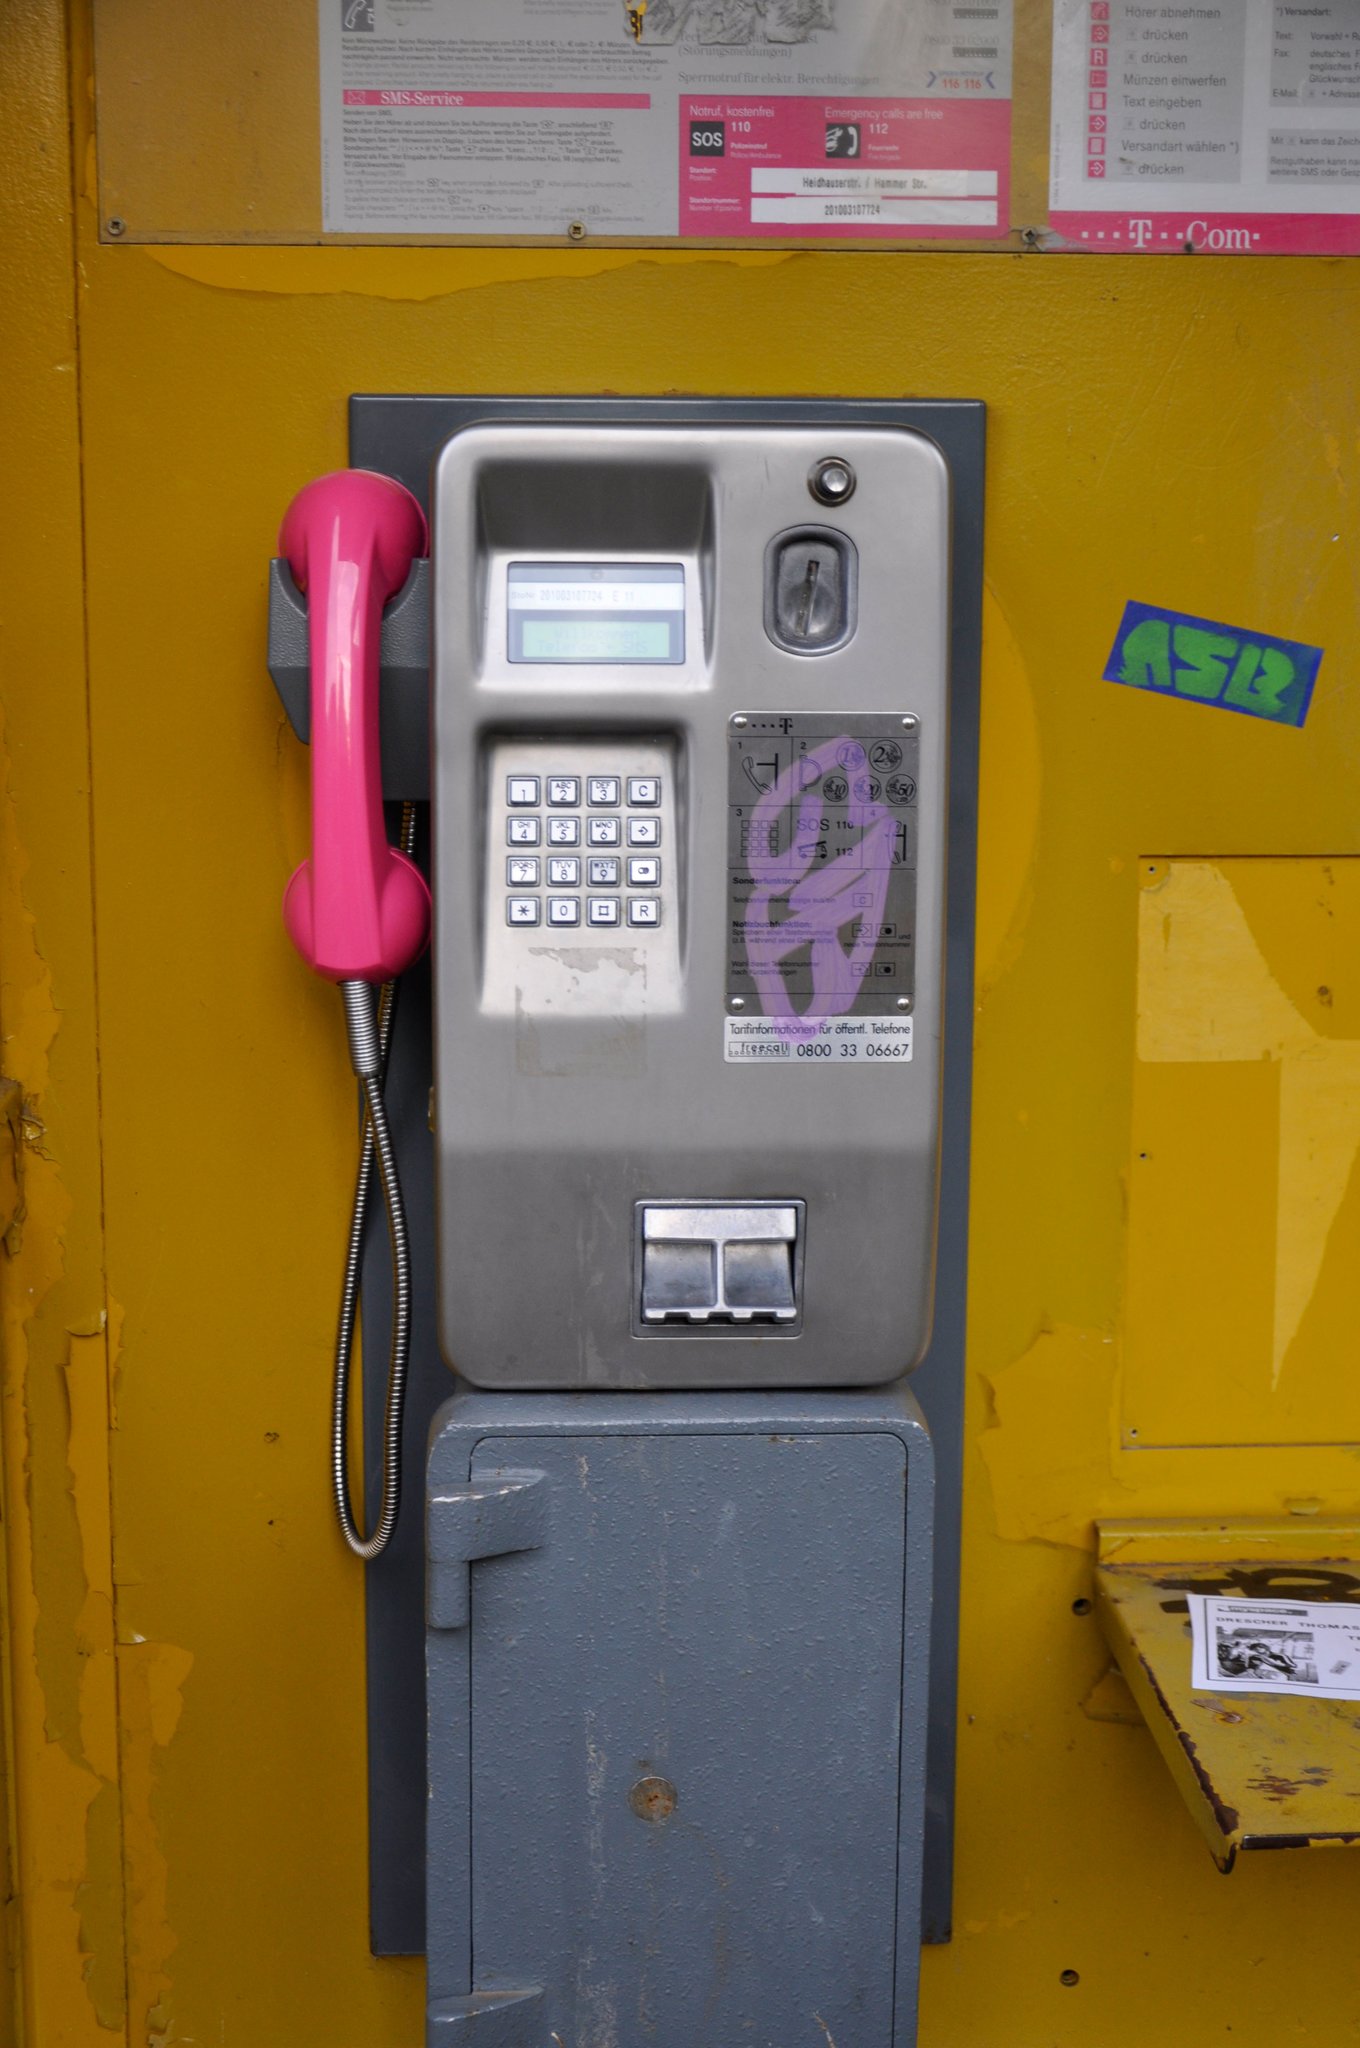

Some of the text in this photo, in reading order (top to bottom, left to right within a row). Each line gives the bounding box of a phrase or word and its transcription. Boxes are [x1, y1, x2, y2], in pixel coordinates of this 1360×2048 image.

[1125, 6, 1221, 19] Hörer abnehmen
[1142, 29, 1188, 41] drücken
[1141, 52, 1188, 64] drücken
[678, 72, 741, 84] Sperrnotruf
[743, 73, 761, 83] für
[1123, 74, 1227, 87] Münzen einwerfen
[381, 92, 464, 106] SMS-Service
[1122, 95, 1203, 110] Text eingeben
[690, 105, 775, 117] Notruf, kostenfrei
[825, 107, 944, 120] Emergency calls are free
[731, 121, 751, 133] 110
[869, 123, 889, 135] 112
[1139, 118, 1186, 130] drücken
[691, 132, 724, 147] SOS
[1121, 139, 1183, 152] Versandart
[1186, 141, 1226, 152] wählen
[1138, 163, 1184, 175] drücken
[874, 178, 908, 189] Hammer
[555, 781, 572, 789] ABC
[638, 784, 649, 797] C
[559, 789, 568, 801] 2
[599, 789, 608, 801] 3
[797, 819, 854, 831] SOS 110
[520, 829, 528, 840] 4
[559, 829, 567, 841] 5
[599, 829, 608, 841] 6
[835, 847, 854, 857] 112
[519, 869, 528, 881] 7
[560, 869, 568, 881] 8
[599, 869, 608, 881] 9
[639, 905, 649, 917] R
[730, 1023, 911, 1035] Tarifinformationen für öffentl. Telefone
[796, 1044, 832, 1057] 0800
[840, 1044, 857, 1057] 33
[866, 1044, 910, 1057] 06667
[1216, 1616, 1360, 1631] DRESCHER THOMAS
